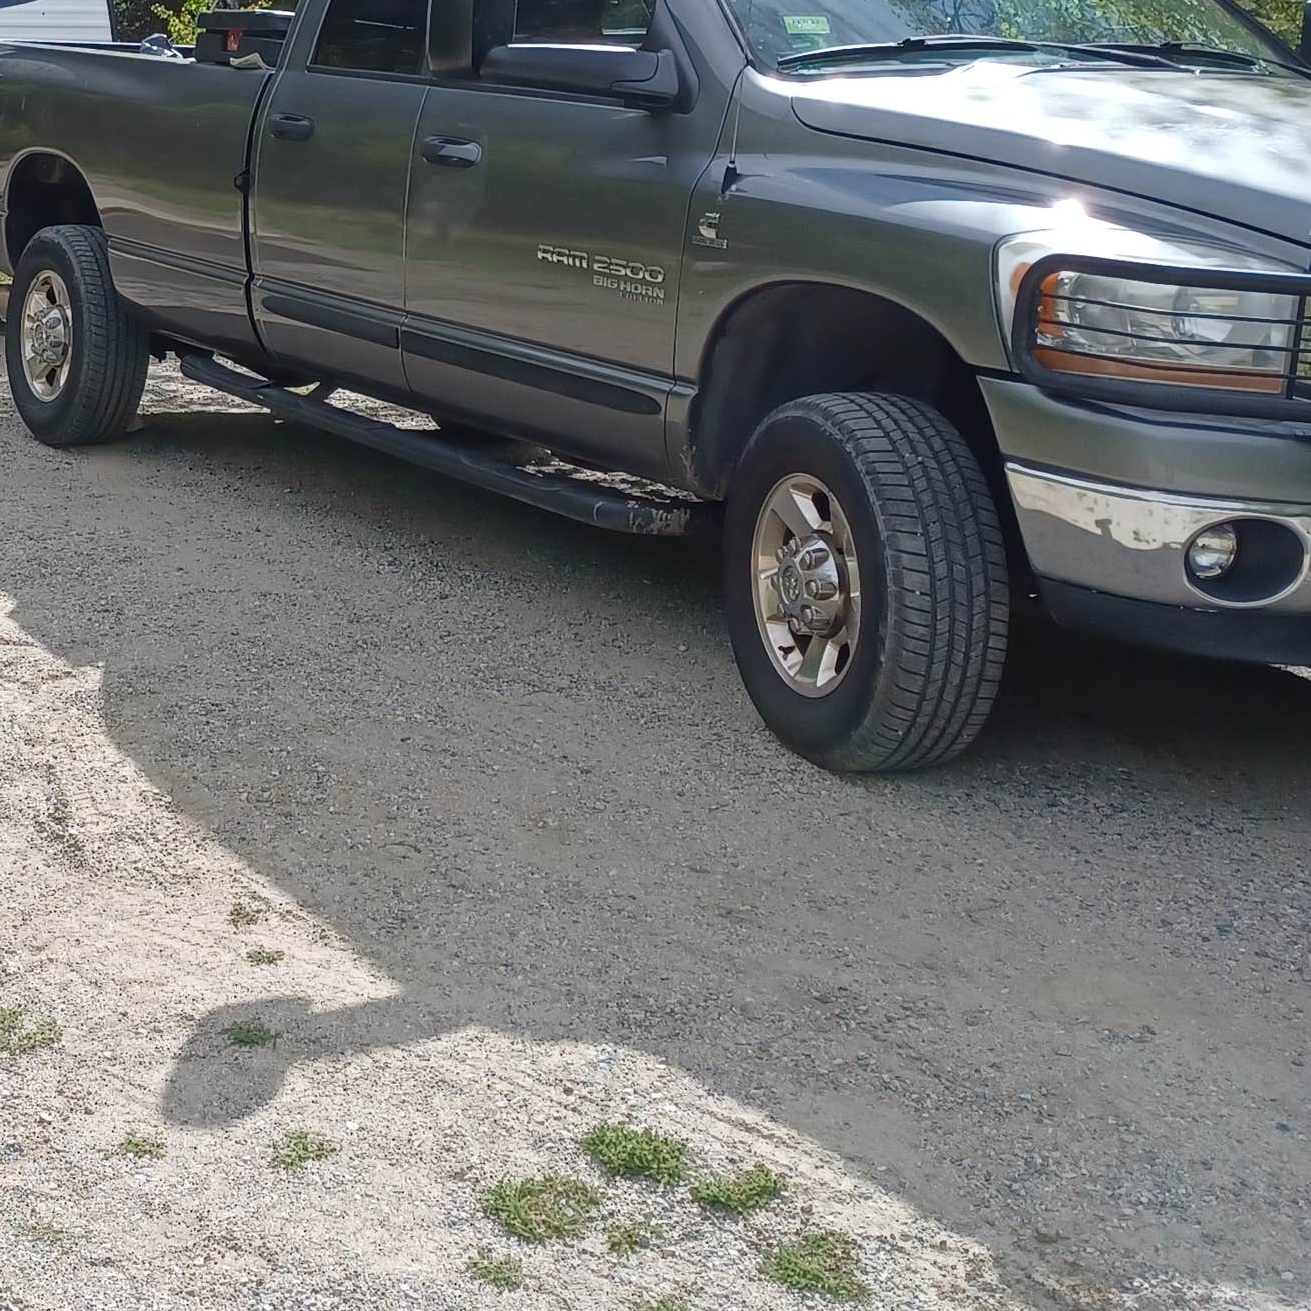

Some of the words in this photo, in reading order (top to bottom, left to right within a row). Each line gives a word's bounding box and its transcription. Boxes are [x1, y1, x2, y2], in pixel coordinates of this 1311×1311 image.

[537, 244, 588, 269] RAM
[593, 255, 665, 283] 2500
[593, 275, 618, 289] BIG
[620, 281, 665, 299] HORN
